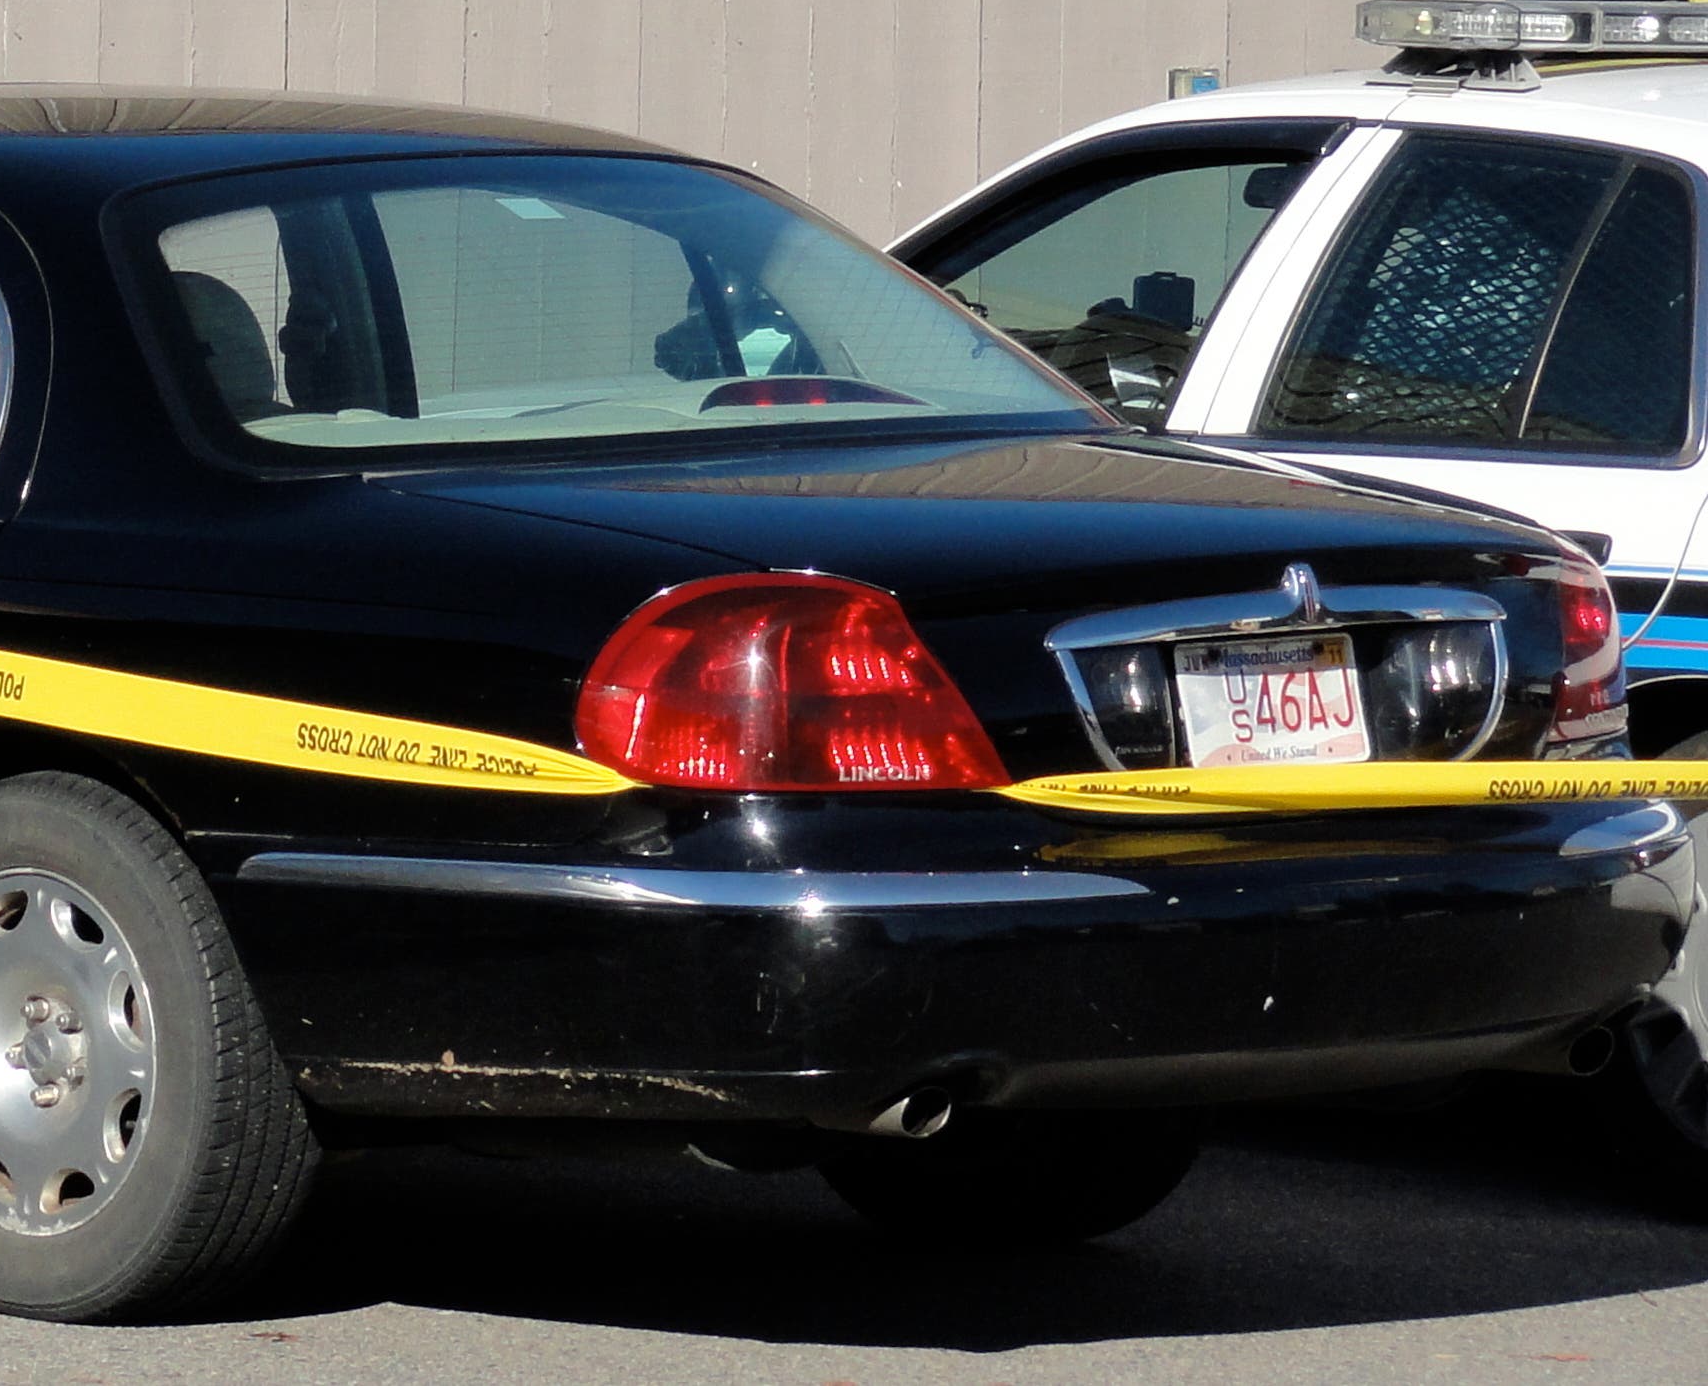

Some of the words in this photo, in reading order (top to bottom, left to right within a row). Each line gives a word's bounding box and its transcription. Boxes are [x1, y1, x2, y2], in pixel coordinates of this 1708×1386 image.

[1327, 648, 1344, 665] 11
[1256, 667, 1355, 733] 46AJ
[297, 722, 353, 756] CROSS
[356, 733, 392, 761] NOT
[394, 740, 421, 764] DO
[428, 745, 468, 769] LINE
[838, 764, 933, 783] LINCOLN
[1489, 779, 1544, 799] CROSS
[1548, 780, 1583, 798] NOT
